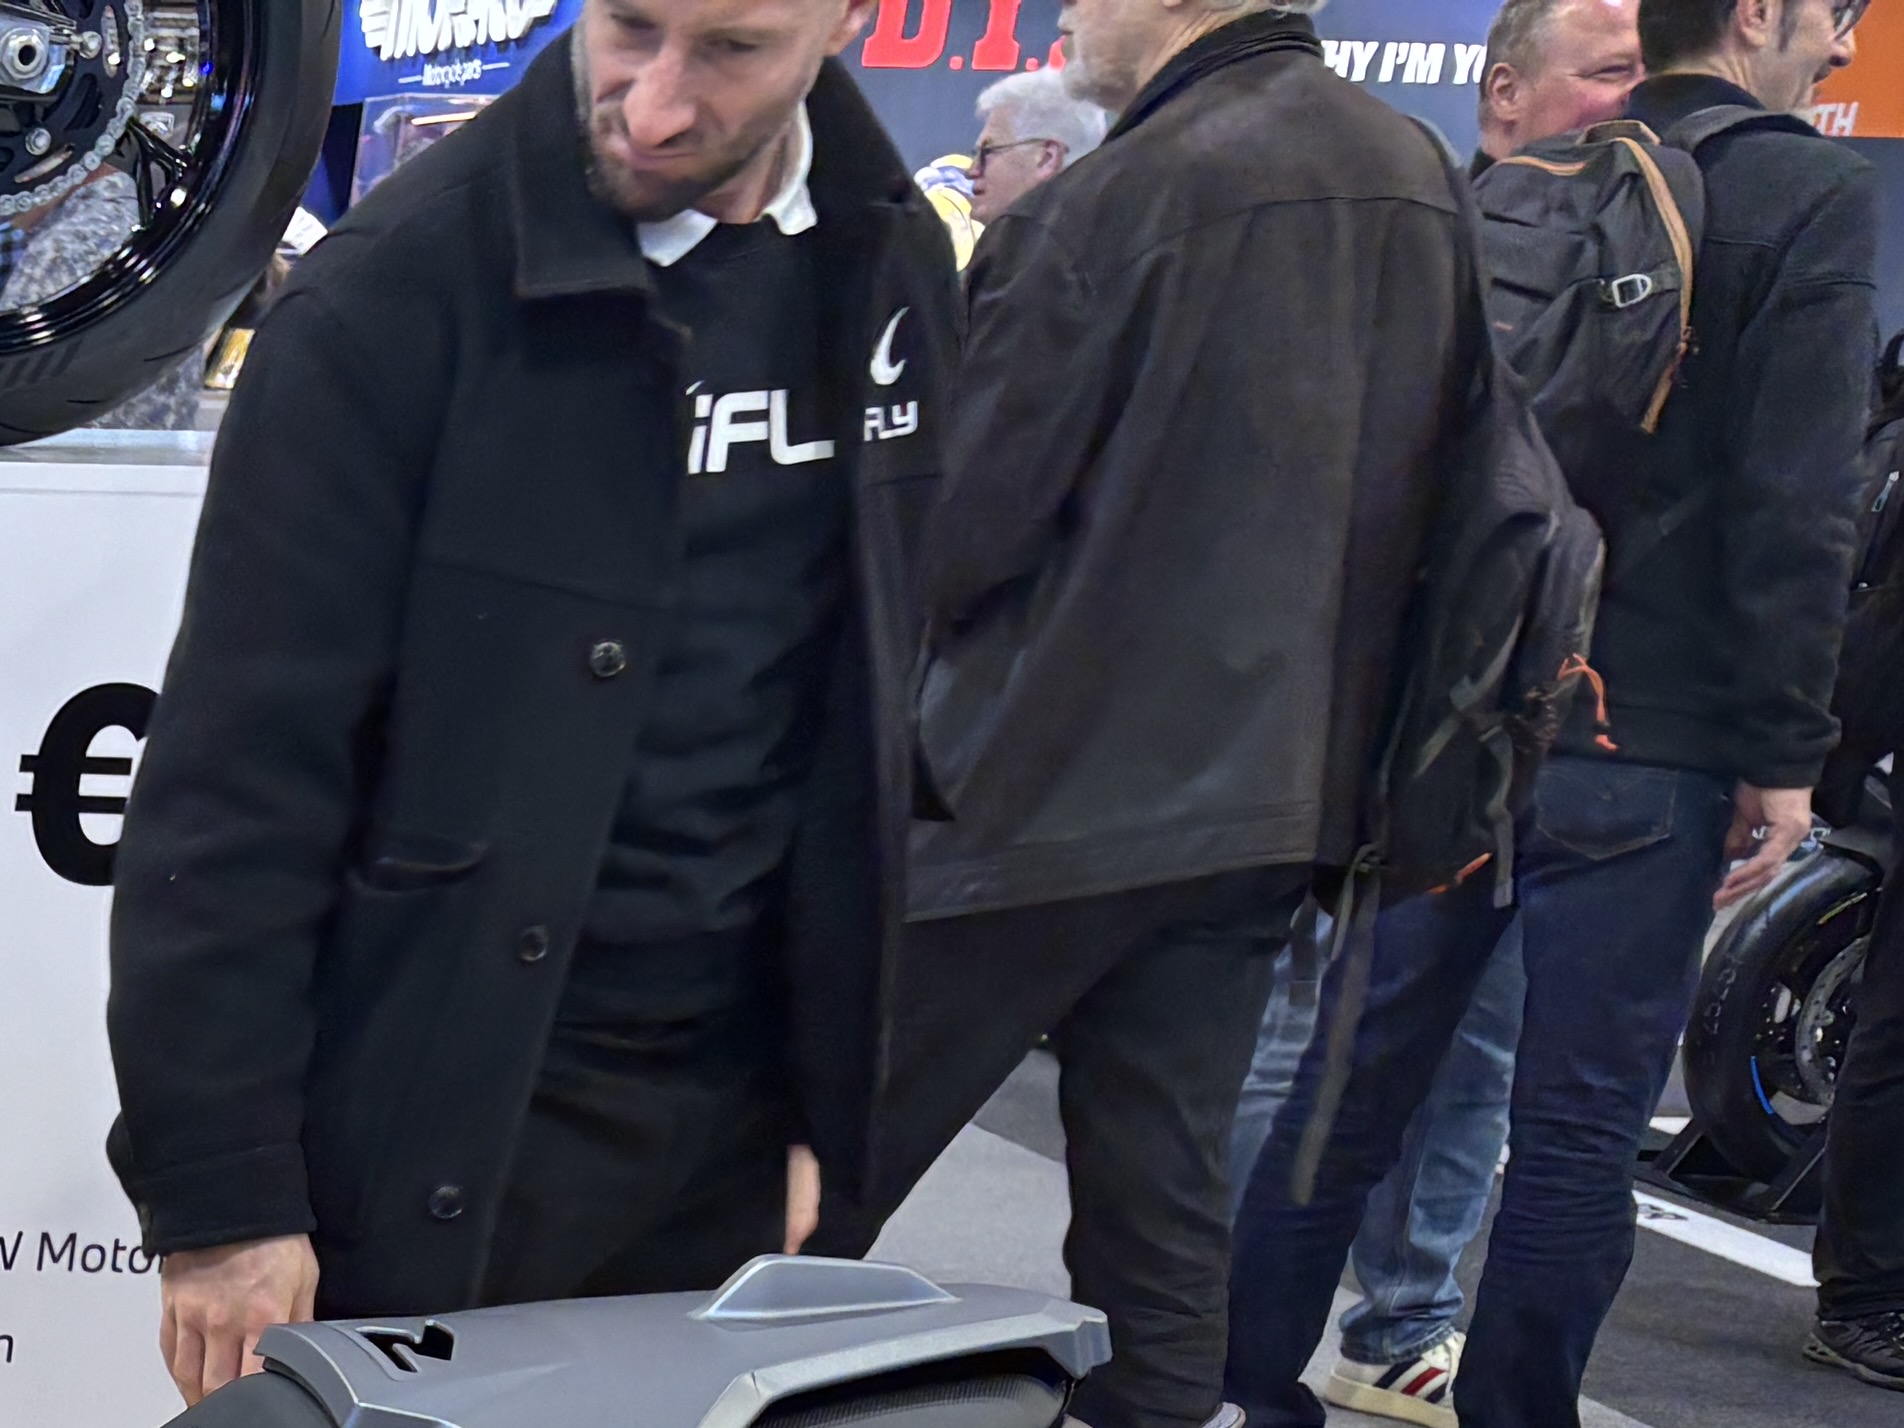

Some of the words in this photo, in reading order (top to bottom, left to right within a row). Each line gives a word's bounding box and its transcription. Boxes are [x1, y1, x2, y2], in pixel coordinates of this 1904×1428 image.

[1320, 40, 1379, 82] HY
[1378, 42, 1446, 84] I'M
[14, 683, 160, 886] €
